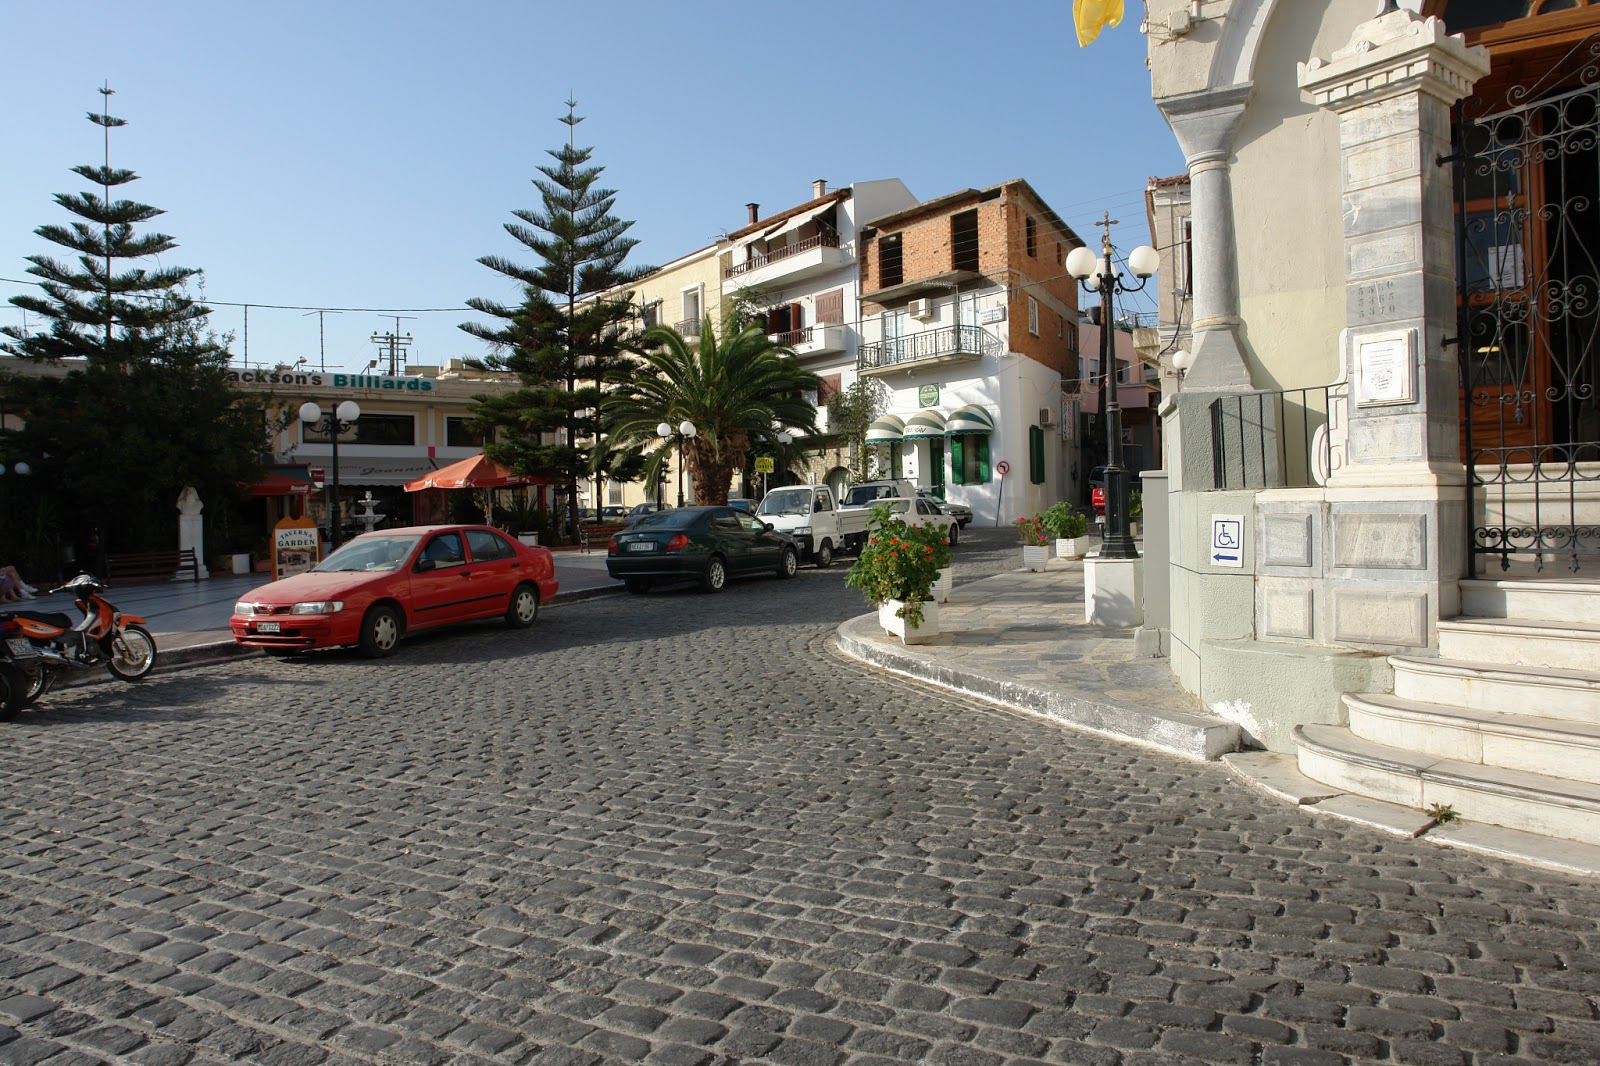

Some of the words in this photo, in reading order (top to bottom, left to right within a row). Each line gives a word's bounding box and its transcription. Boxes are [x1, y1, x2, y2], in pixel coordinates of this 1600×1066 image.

[227, 370, 323, 387] ackson's
[333, 373, 432, 391] Billiards
[280, 530, 313, 540] TAVERNA
[278, 539, 315, 547] GARDEN
